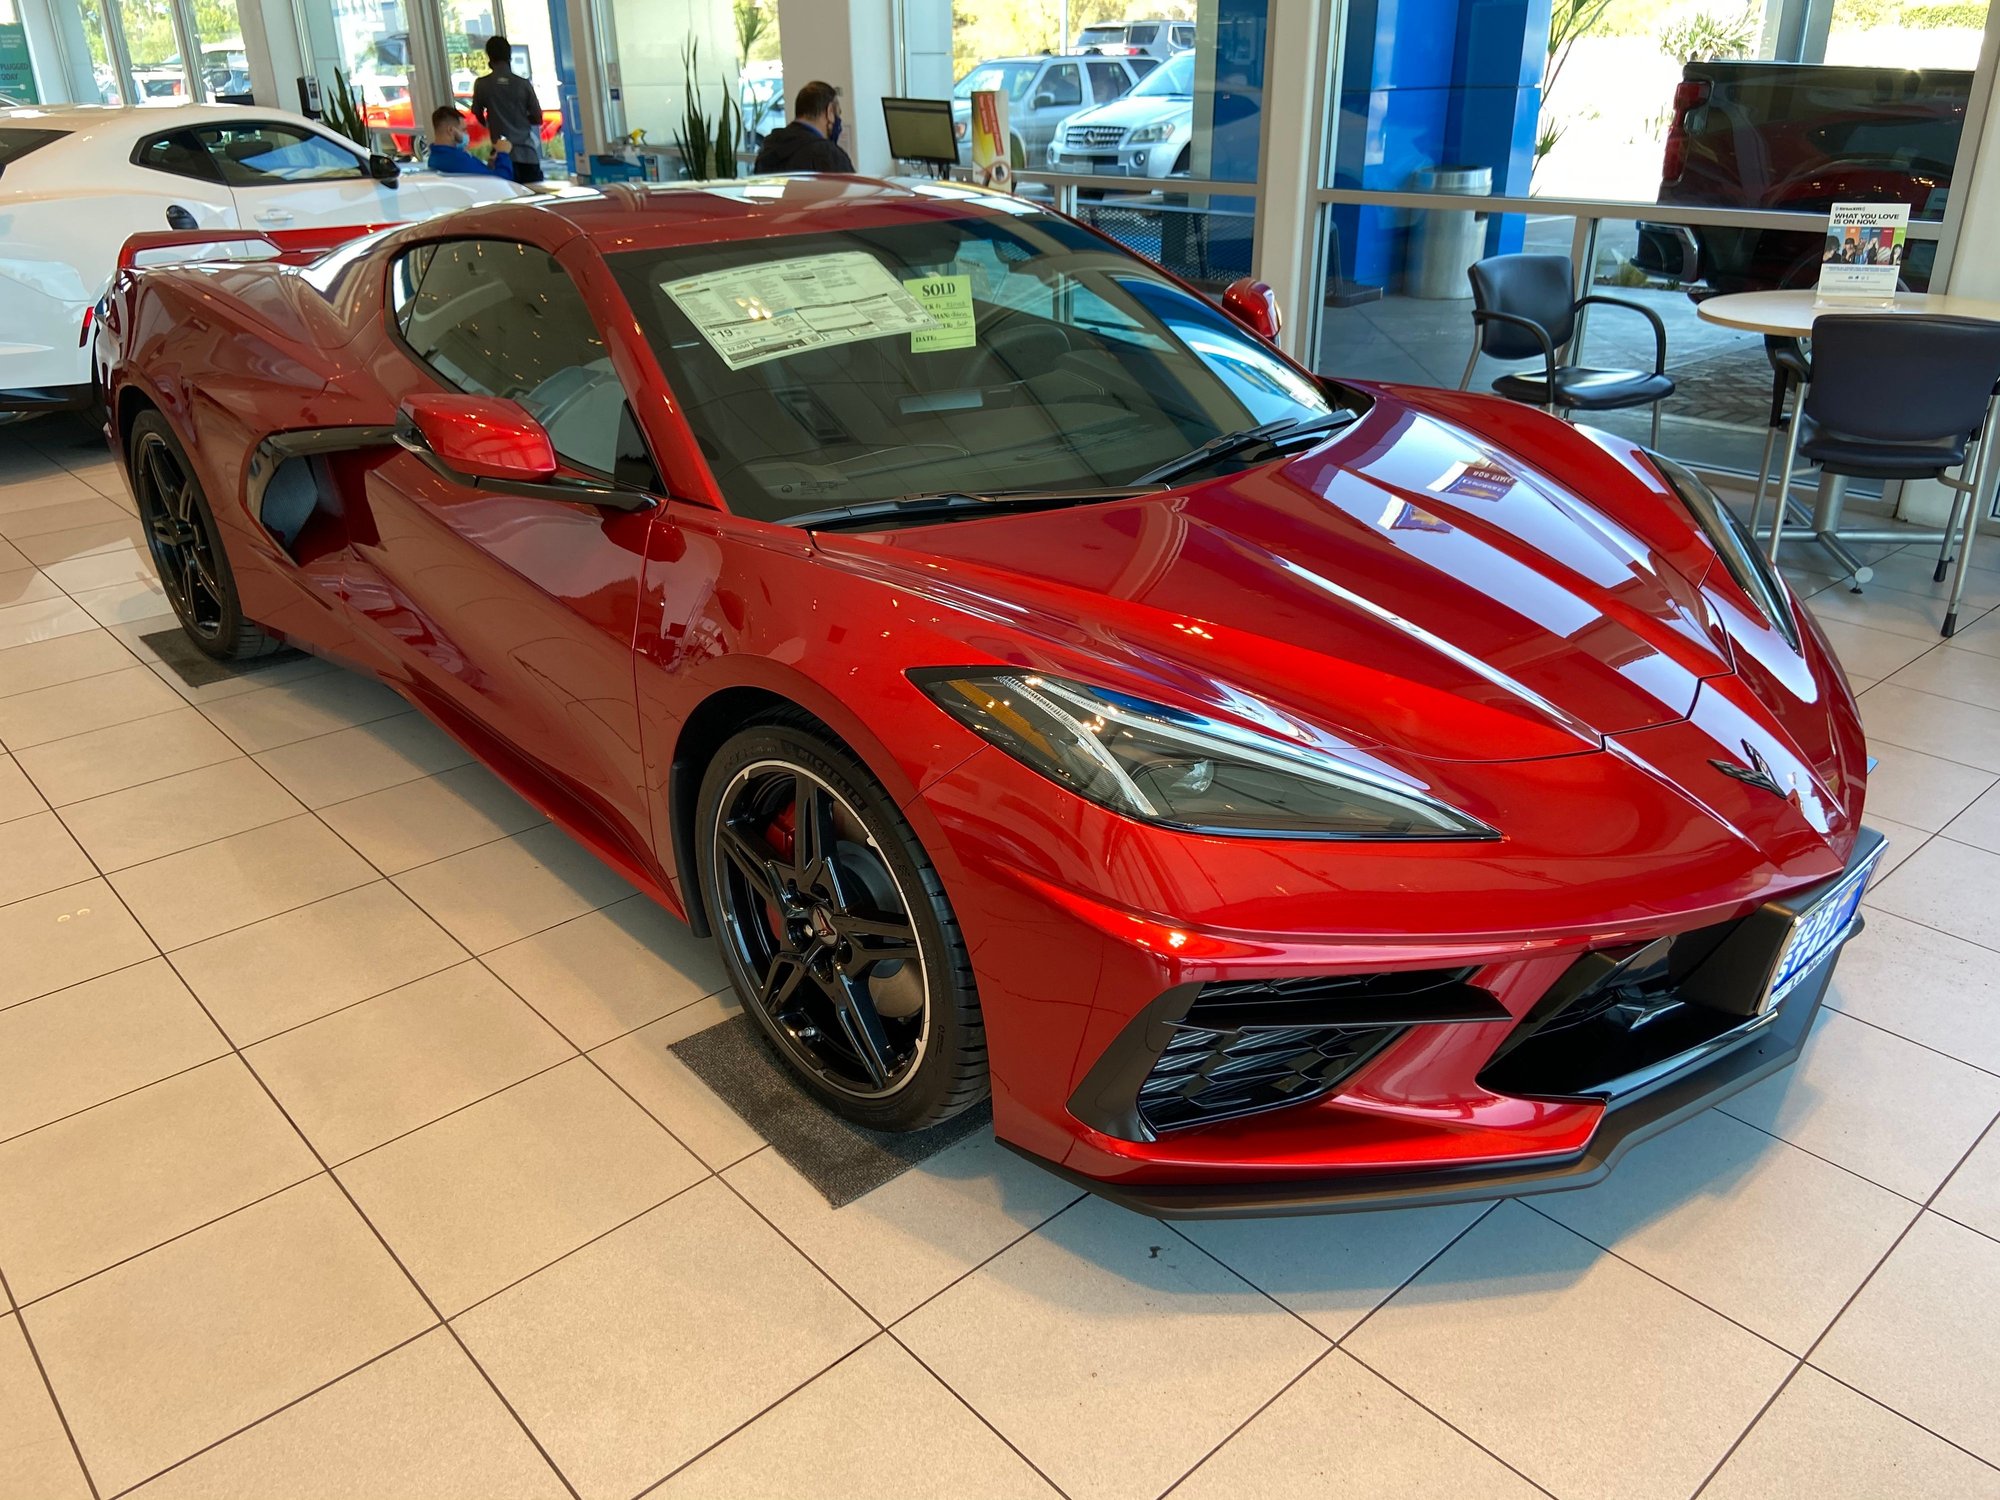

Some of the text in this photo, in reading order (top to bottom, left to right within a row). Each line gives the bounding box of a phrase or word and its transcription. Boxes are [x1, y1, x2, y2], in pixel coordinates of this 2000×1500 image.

[922, 282, 956, 297] SOLD
[717, 328, 734, 338] 19
[915, 335, 937, 343] DATE:
[797, 750, 864, 808] MICHELIN
[1786, 896, 1840, 955] BOB
[1773, 911, 1842, 987] STALL
